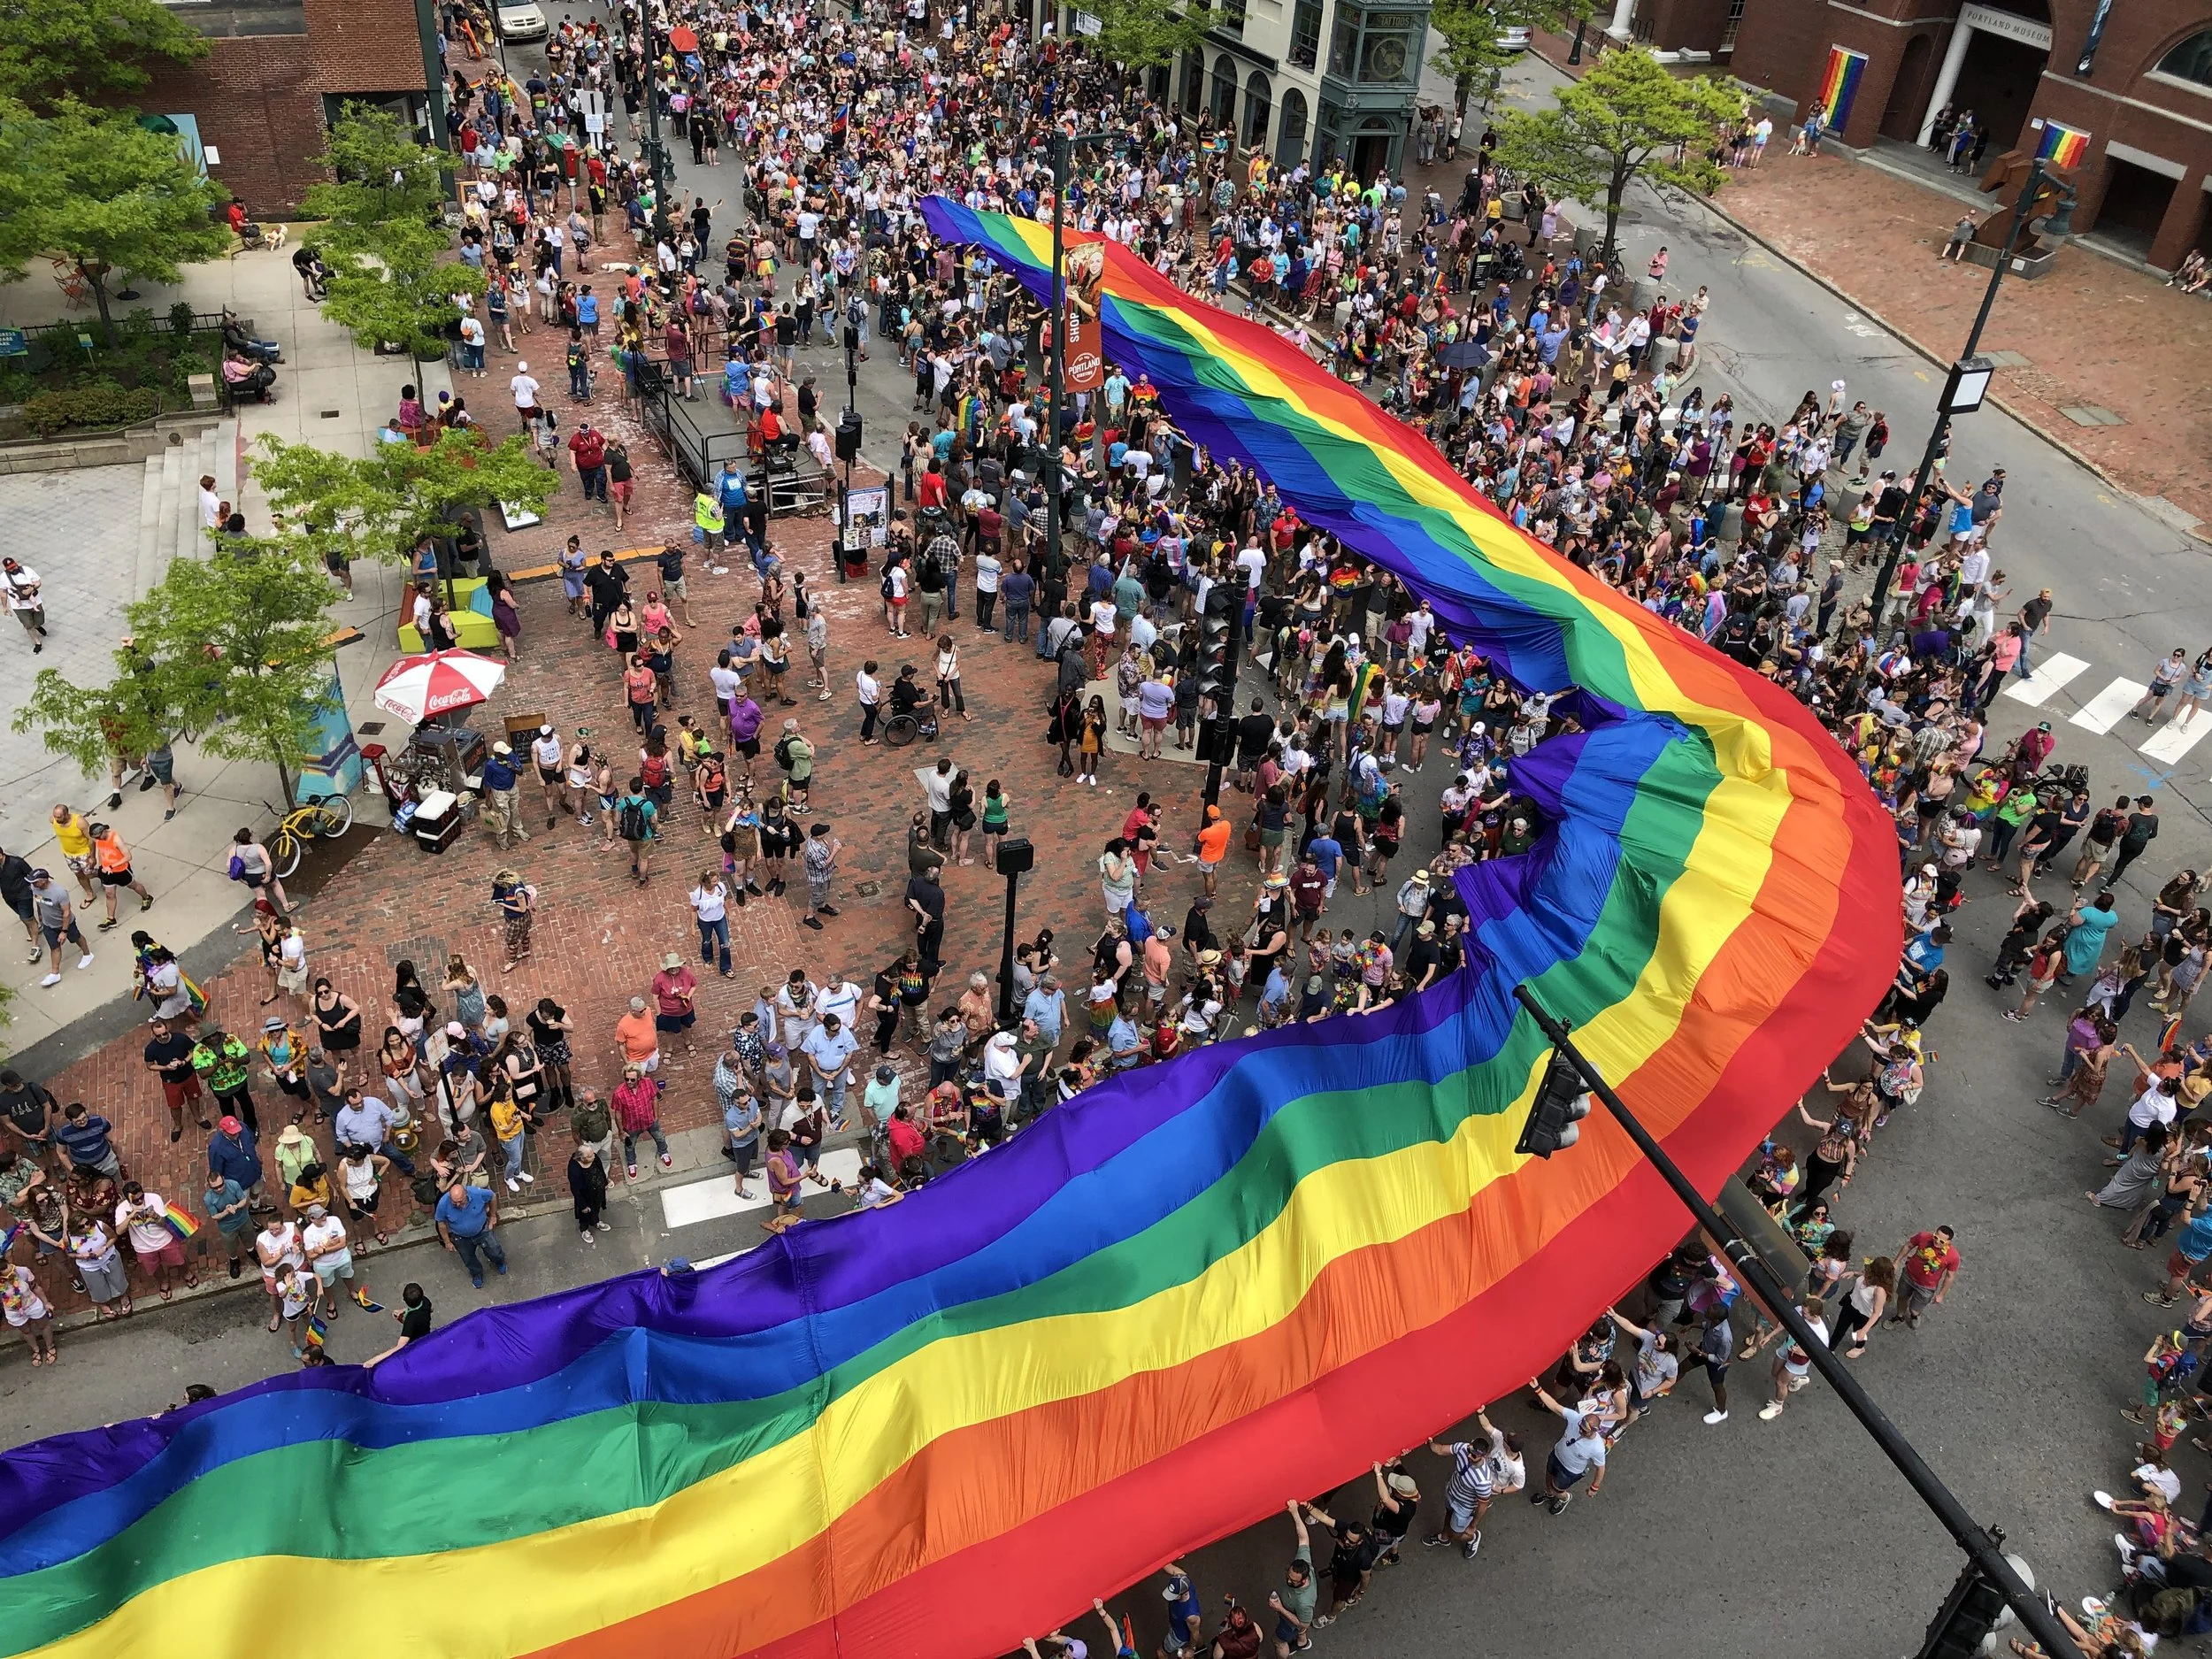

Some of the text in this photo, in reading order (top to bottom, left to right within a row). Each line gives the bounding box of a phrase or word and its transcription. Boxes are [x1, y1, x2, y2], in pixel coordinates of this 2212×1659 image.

[1380, 17, 1409, 26] TATTOOS
[1967, 11, 2050, 42] PORTLAND MUSEUM
[1069, 312, 1079, 343] SHOP
[1068, 357, 1100, 375] PORTLAND
[429, 687, 471, 710] Coca-Cola
